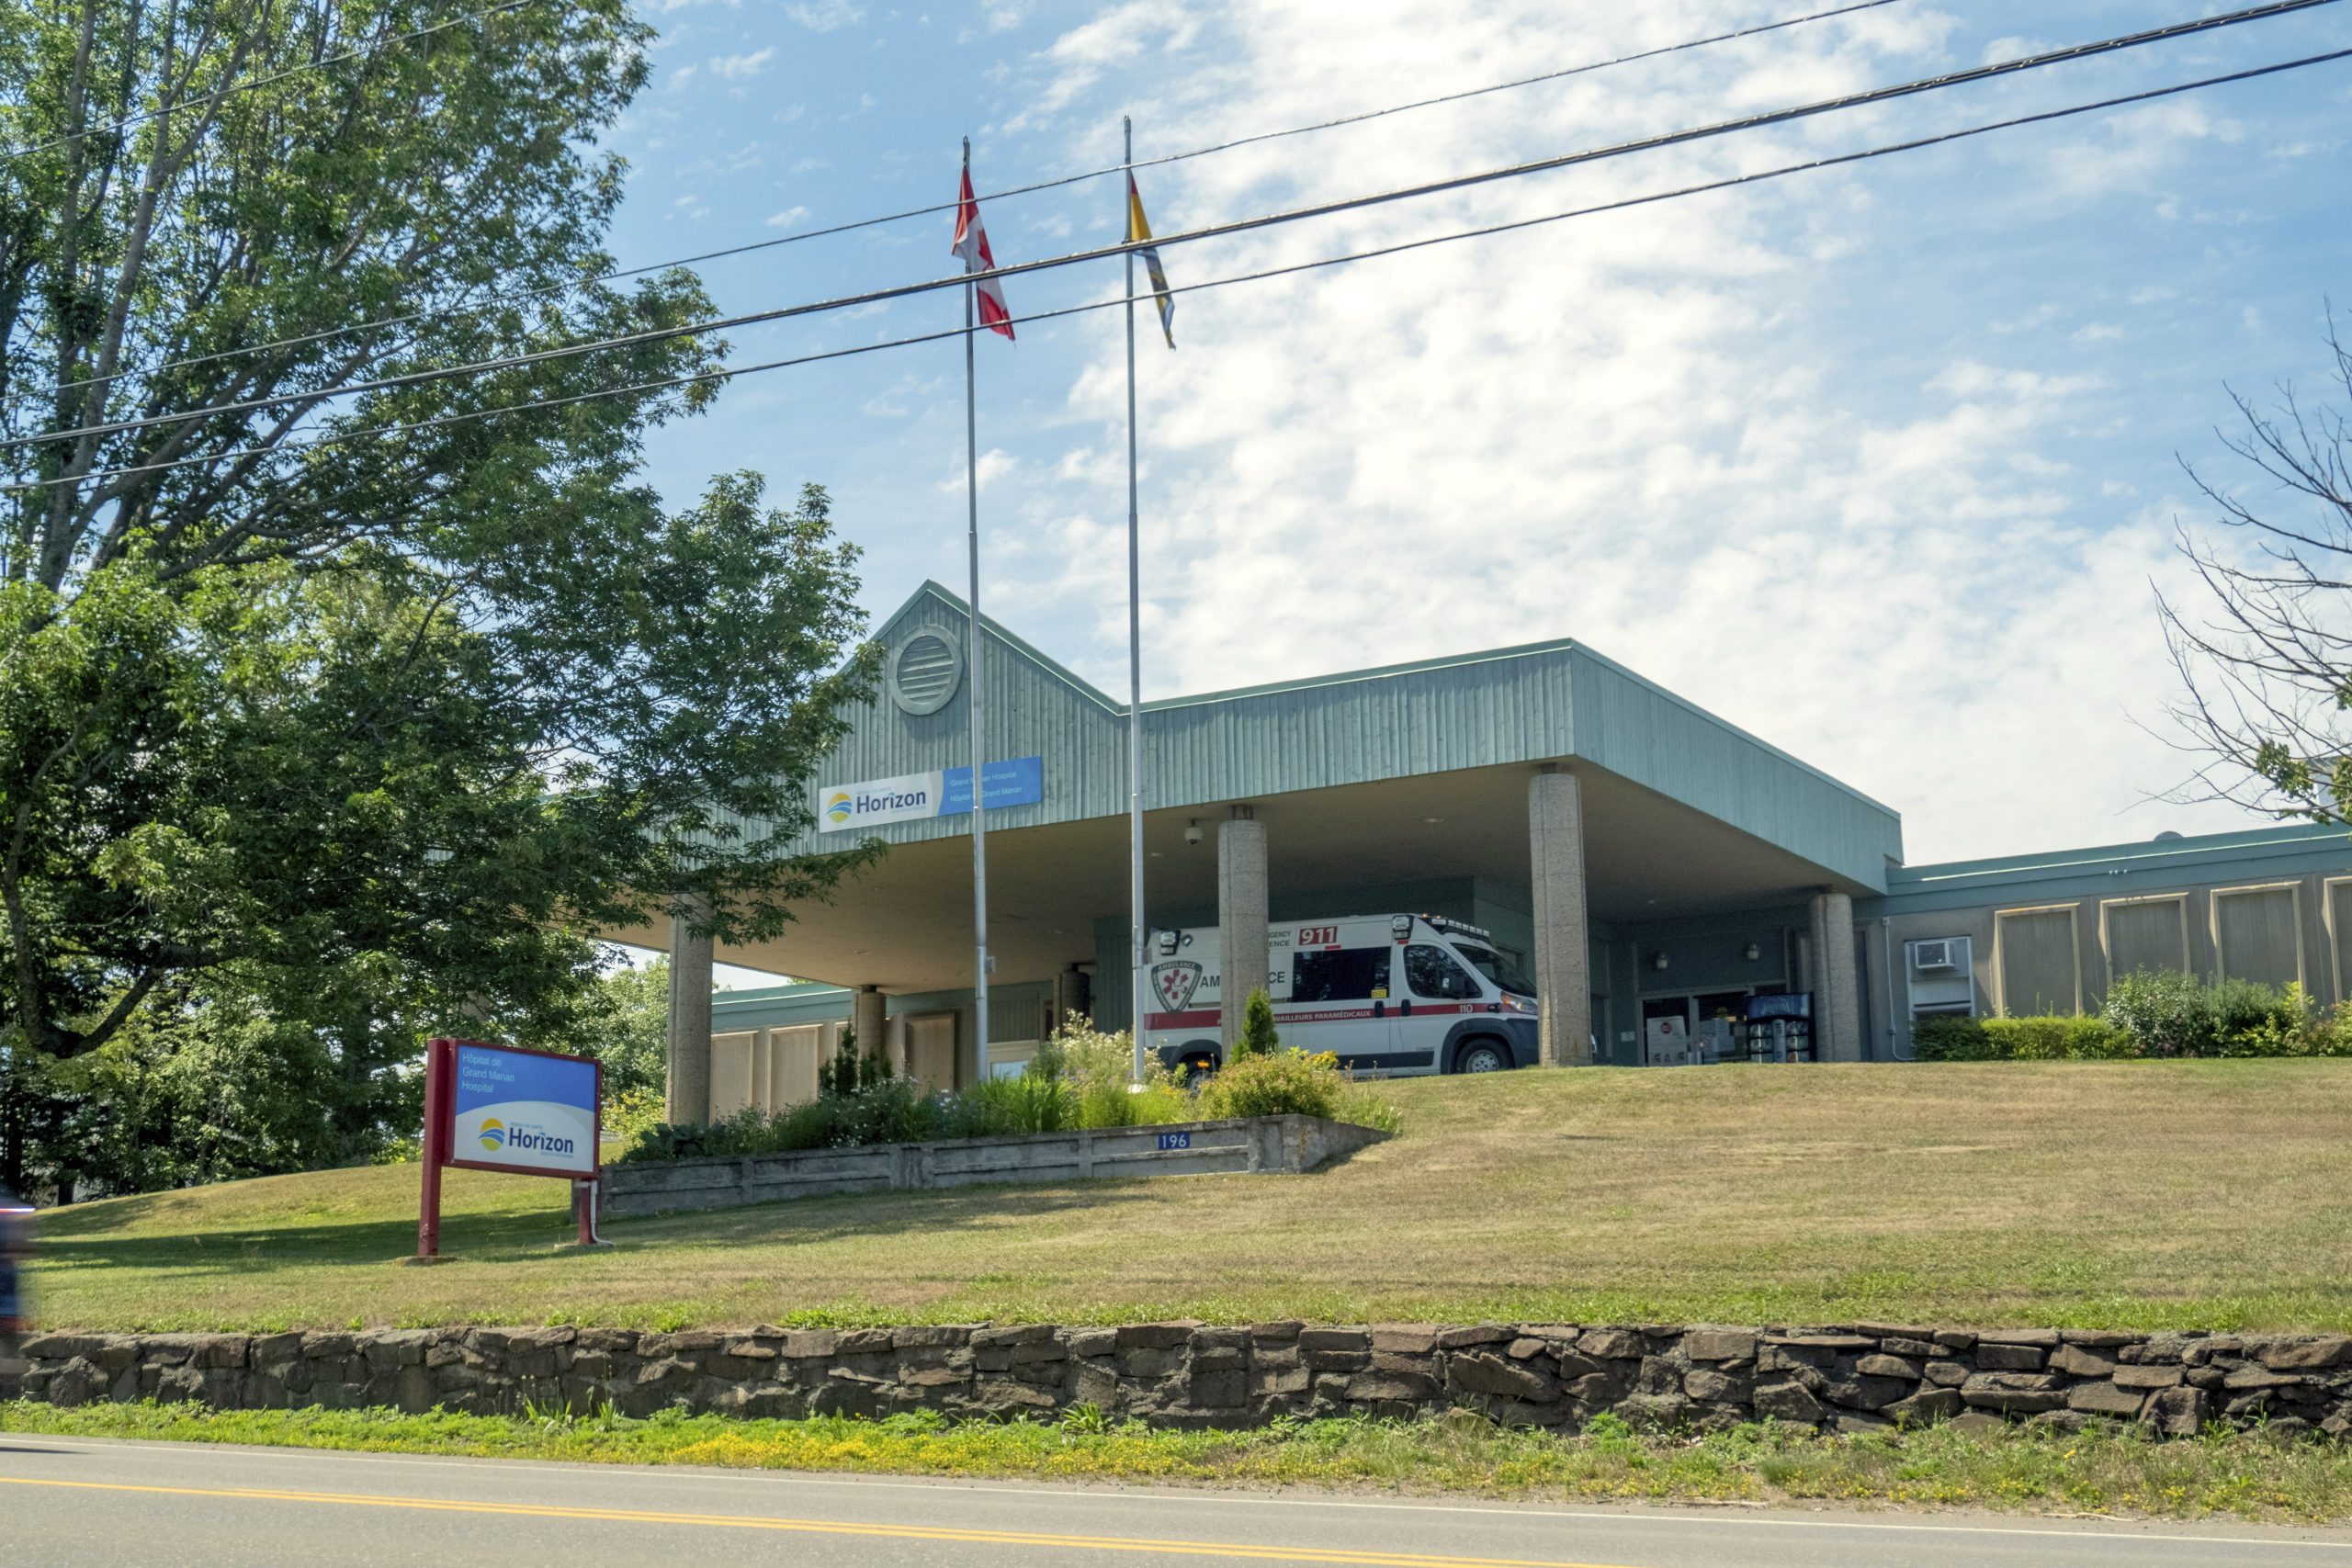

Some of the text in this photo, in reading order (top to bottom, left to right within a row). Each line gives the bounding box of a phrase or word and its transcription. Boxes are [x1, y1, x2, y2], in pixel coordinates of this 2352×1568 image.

[950, 778, 968, 786] Grand
[992, 772, 1016, 780] Hospital
[950, 793, 971, 802] Hôpital
[1001, 786, 1023, 795] Manan
[856, 791, 926, 814] Horizon
[1301, 927, 1335, 945] 911
[1158, 962, 1195, 971] AMBULANCE
[1273, 1010, 1371, 1021] AVAILLEURS PARAMÉDICAUX
[1459, 1004, 1474, 1013] 110
[462, 1054, 501, 1067] Hôpital de
[462, 1066, 514, 1082] Grand Manan
[461, 1079, 493, 1094] Hospital
[509, 1127, 573, 1154] Horizon
[1162, 1134, 1187, 1148] 196
